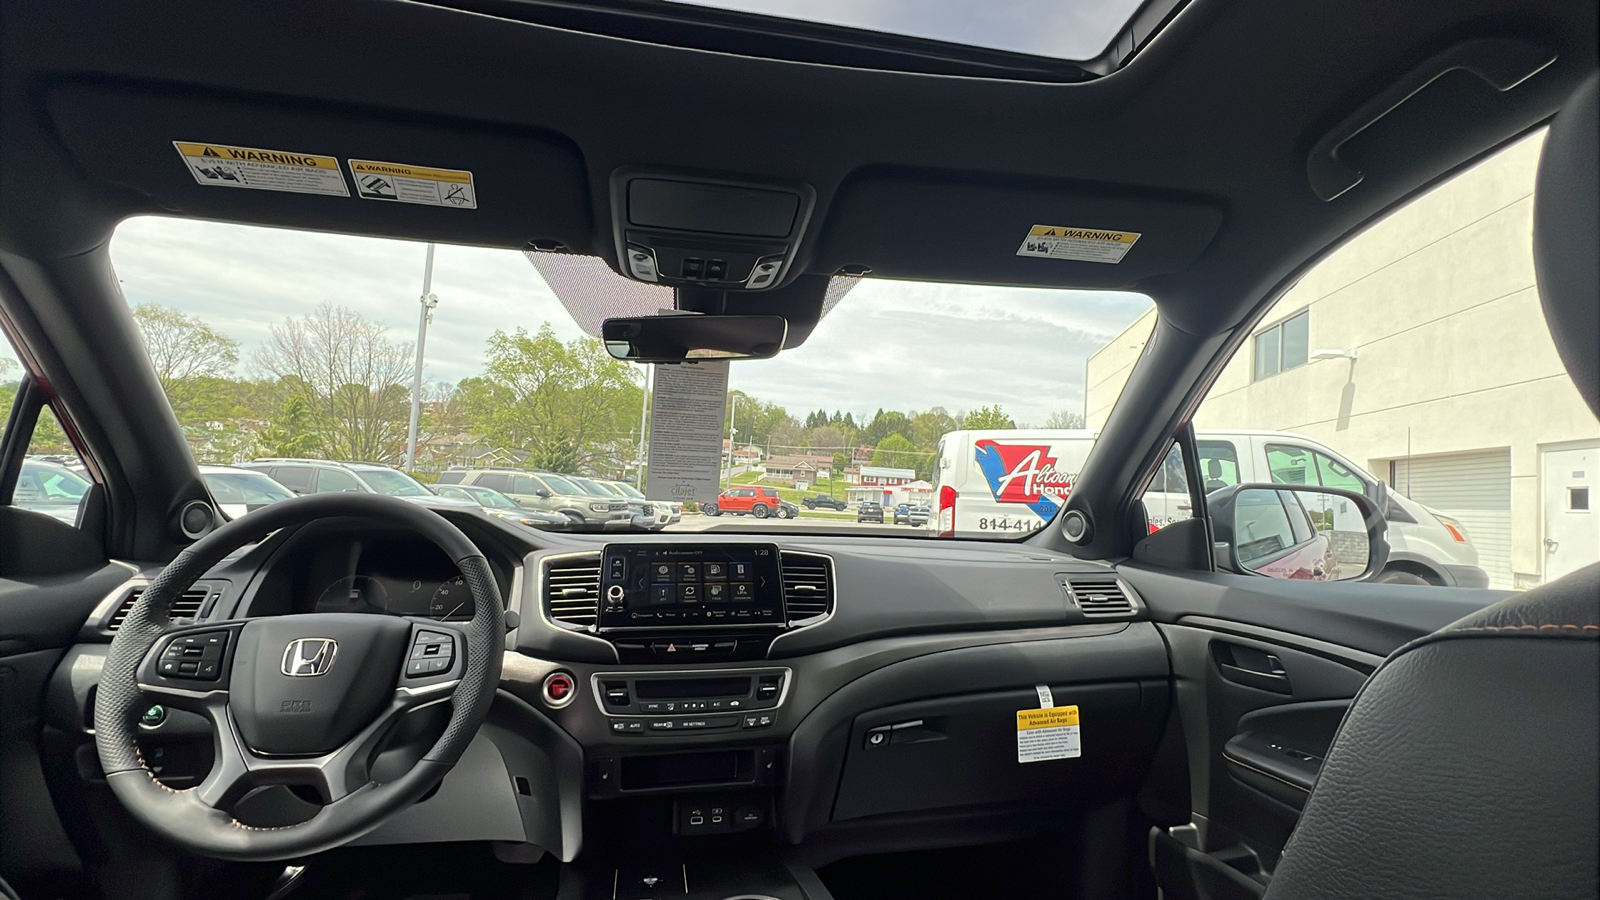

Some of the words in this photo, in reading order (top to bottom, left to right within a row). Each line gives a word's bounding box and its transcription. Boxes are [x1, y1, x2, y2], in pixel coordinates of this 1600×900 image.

[228, 149, 317, 166] WARNING
[365, 165, 412, 175] WARNING
[1063, 230, 1123, 241] WARNING
